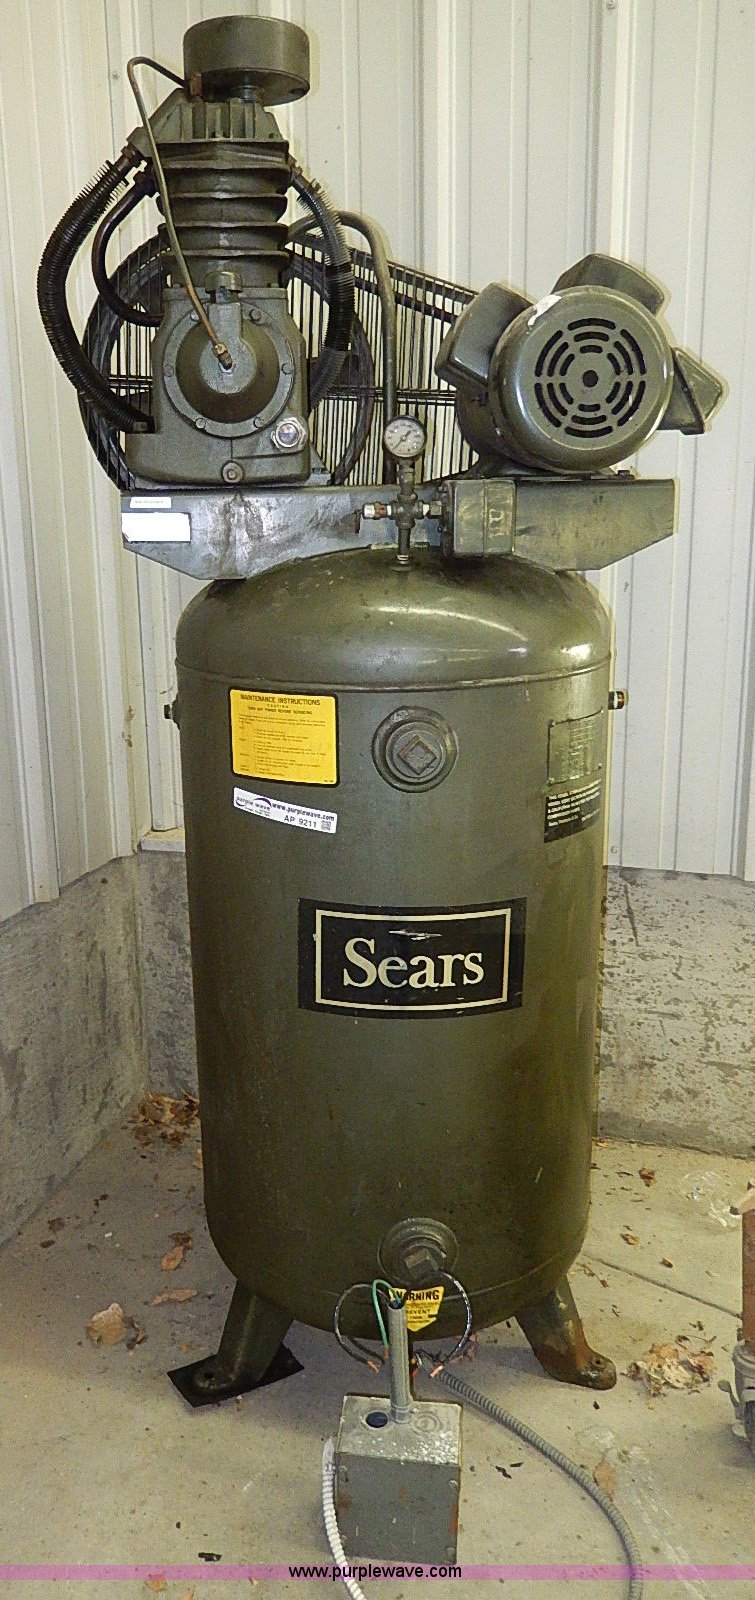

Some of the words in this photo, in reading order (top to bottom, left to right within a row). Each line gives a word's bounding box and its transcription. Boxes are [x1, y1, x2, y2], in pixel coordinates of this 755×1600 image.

[240, 694, 275, 704] MAINTENANCE
[278, 697, 321, 706] INSTRUCTIONS
[272, 802, 335, 821] www.purplewave.com
[284, 814, 295, 823] AP
[299, 819, 317, 828] 9211
[343, 937, 485, 989] Sears
[393, 1290, 440, 1301] RNING
